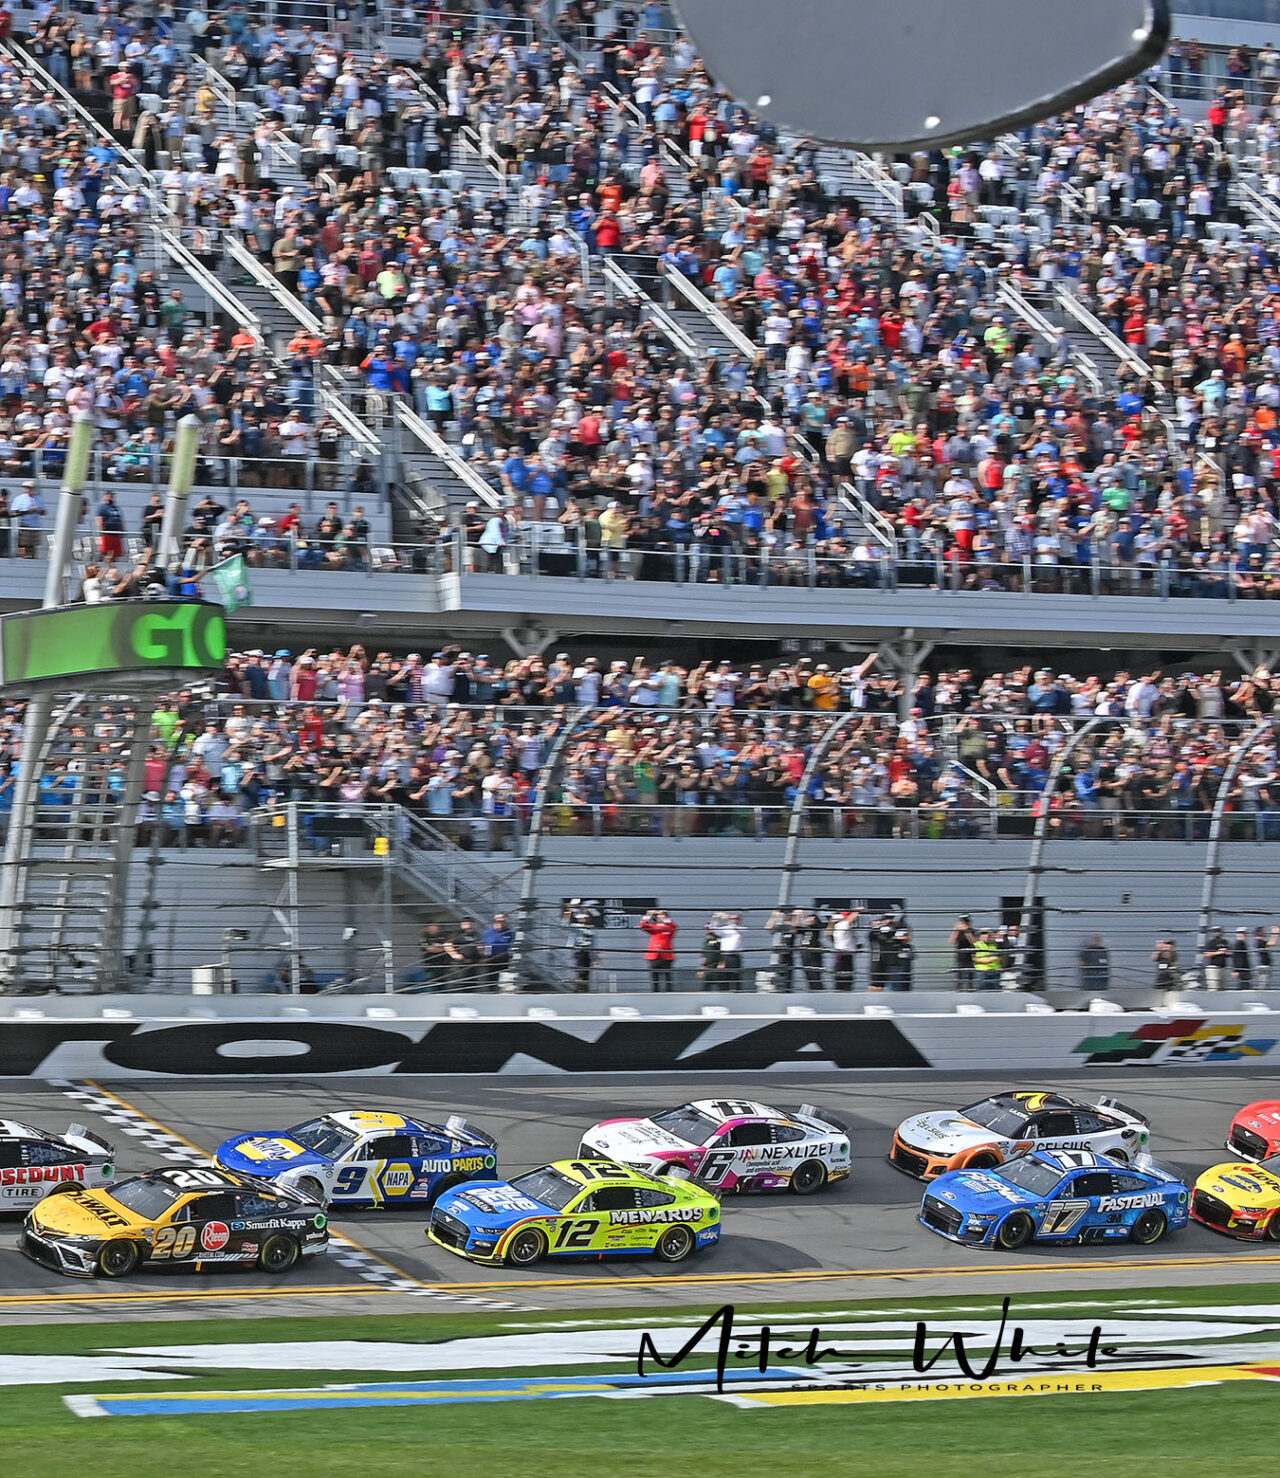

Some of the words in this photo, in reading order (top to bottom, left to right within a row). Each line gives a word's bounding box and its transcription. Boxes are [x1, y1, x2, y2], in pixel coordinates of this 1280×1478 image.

[1013, 1092, 1050, 1111] 7
[761, 1142, 834, 1159] NEXLIZET
[1045, 1150, 1098, 1169] 17
[421, 1159, 451, 1173] AUTO
[453, 1157, 485, 1172] PARTS
[571, 1162, 631, 1178] 12
[696, 1150, 737, 1183] 6
[162, 1169, 224, 1188] 20
[332, 1166, 368, 1194] 9
[386, 1172, 410, 1187] NAPA
[6, 1188, 39, 1197] TIRE
[1097, 1192, 1166, 1213] FASTENAL
[246, 1218, 280, 1230] Smurfit
[280, 1218, 307, 1230] Kappa
[609, 1207, 704, 1225] MENARDS
[1037, 1200, 1090, 1236] 17
[151, 1226, 197, 1259] 20
[204, 1222, 229, 1246] Rheem
[554, 1219, 601, 1249] 12
